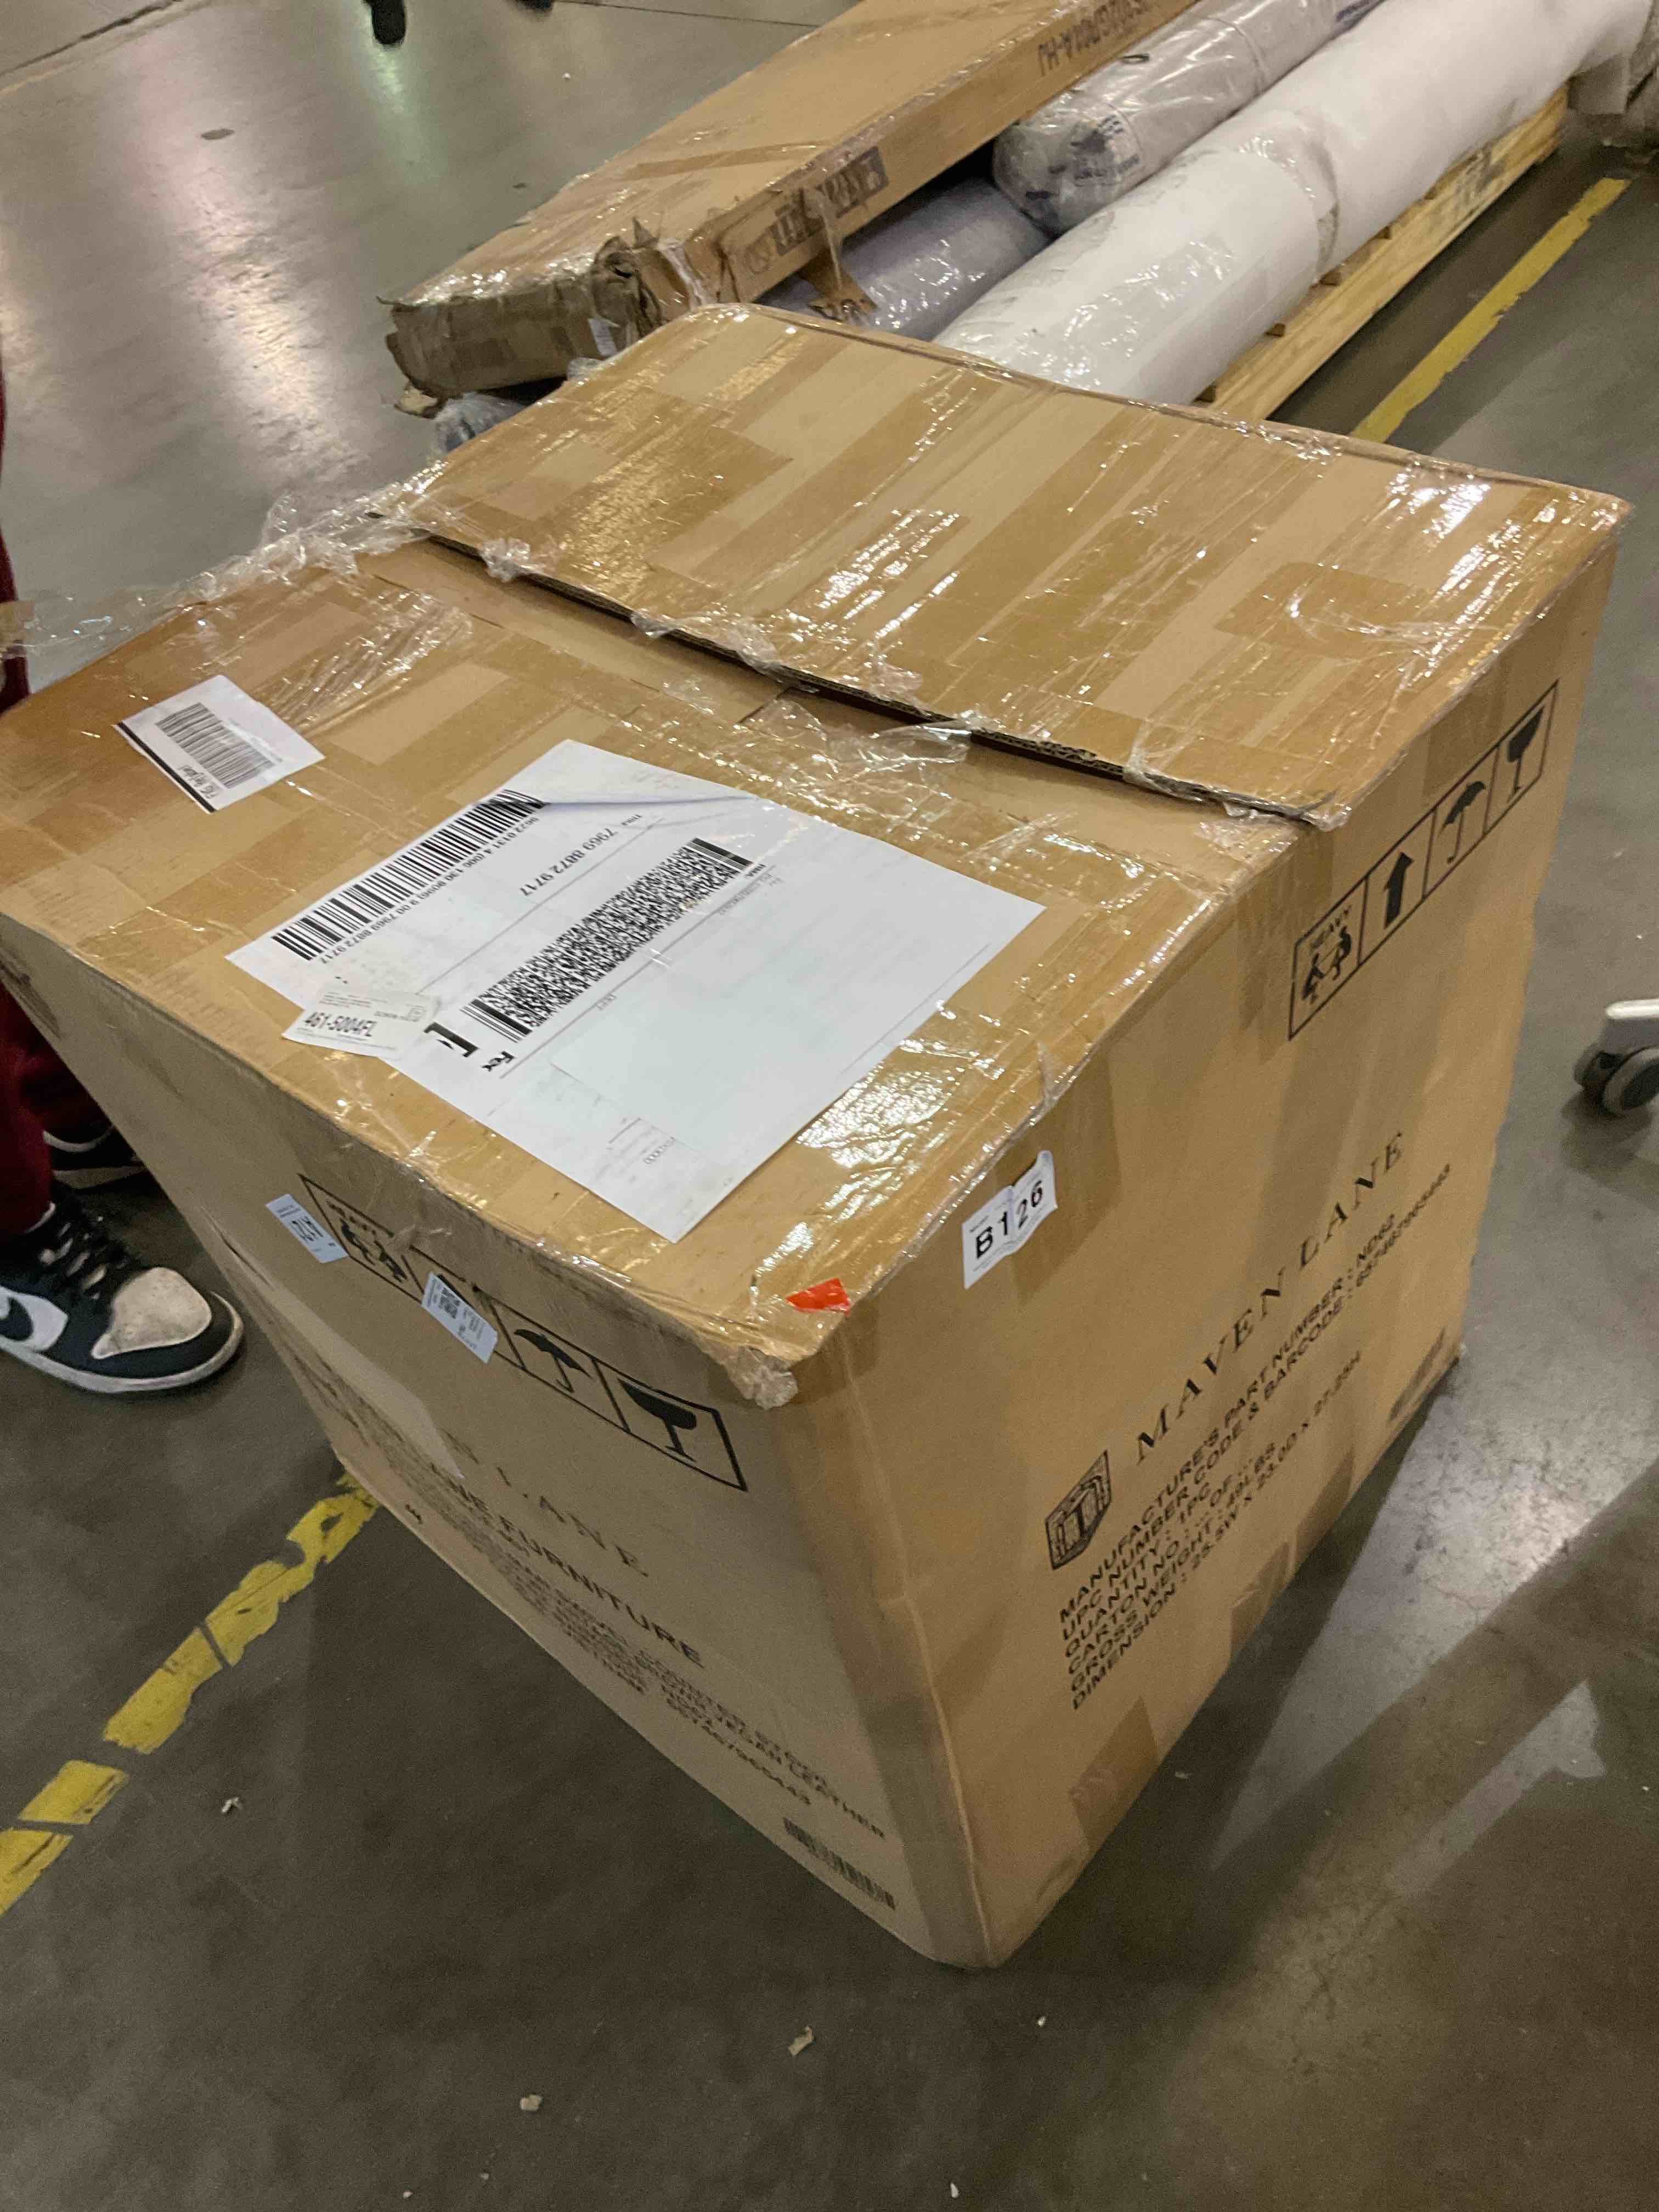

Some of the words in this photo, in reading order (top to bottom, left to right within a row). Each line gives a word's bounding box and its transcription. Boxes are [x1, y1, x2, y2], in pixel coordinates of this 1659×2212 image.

[516, 872, 555, 896] 9717
[548, 849, 587, 874] 8872
[580, 827, 618, 851] 7969
[317, 945, 348, 964] 9717
[974, 1180, 1043, 1260] B126
[1134, 1266, 1288, 1464] MAVEN
[1297, 1130, 1404, 1272] LANE
[1059, 1423, 1220, 1624] MANUFACTURE'S
[1224, 1365, 1266, 1429] PART
[1273, 1273, 1342, 1370] NUMBER
[1063, 1585, 1103, 1641] UPC
[1109, 1484, 1187, 1587] NUMBER
[1194, 1417, 1242, 1487] CODE
[1264, 1293, 1342, 1401] BARCODE
[1064, 1539, 1160, 1661] QUANTITY
[1068, 1574, 1147, 1677] CARTON
[1152, 1536, 1178, 1578] NO
[1070, 1605, 1138, 1694] GROSS
[1142, 1516, 1211, 1611] WEIGHT
[1073, 1580, 1176, 1711] DIMENSION
